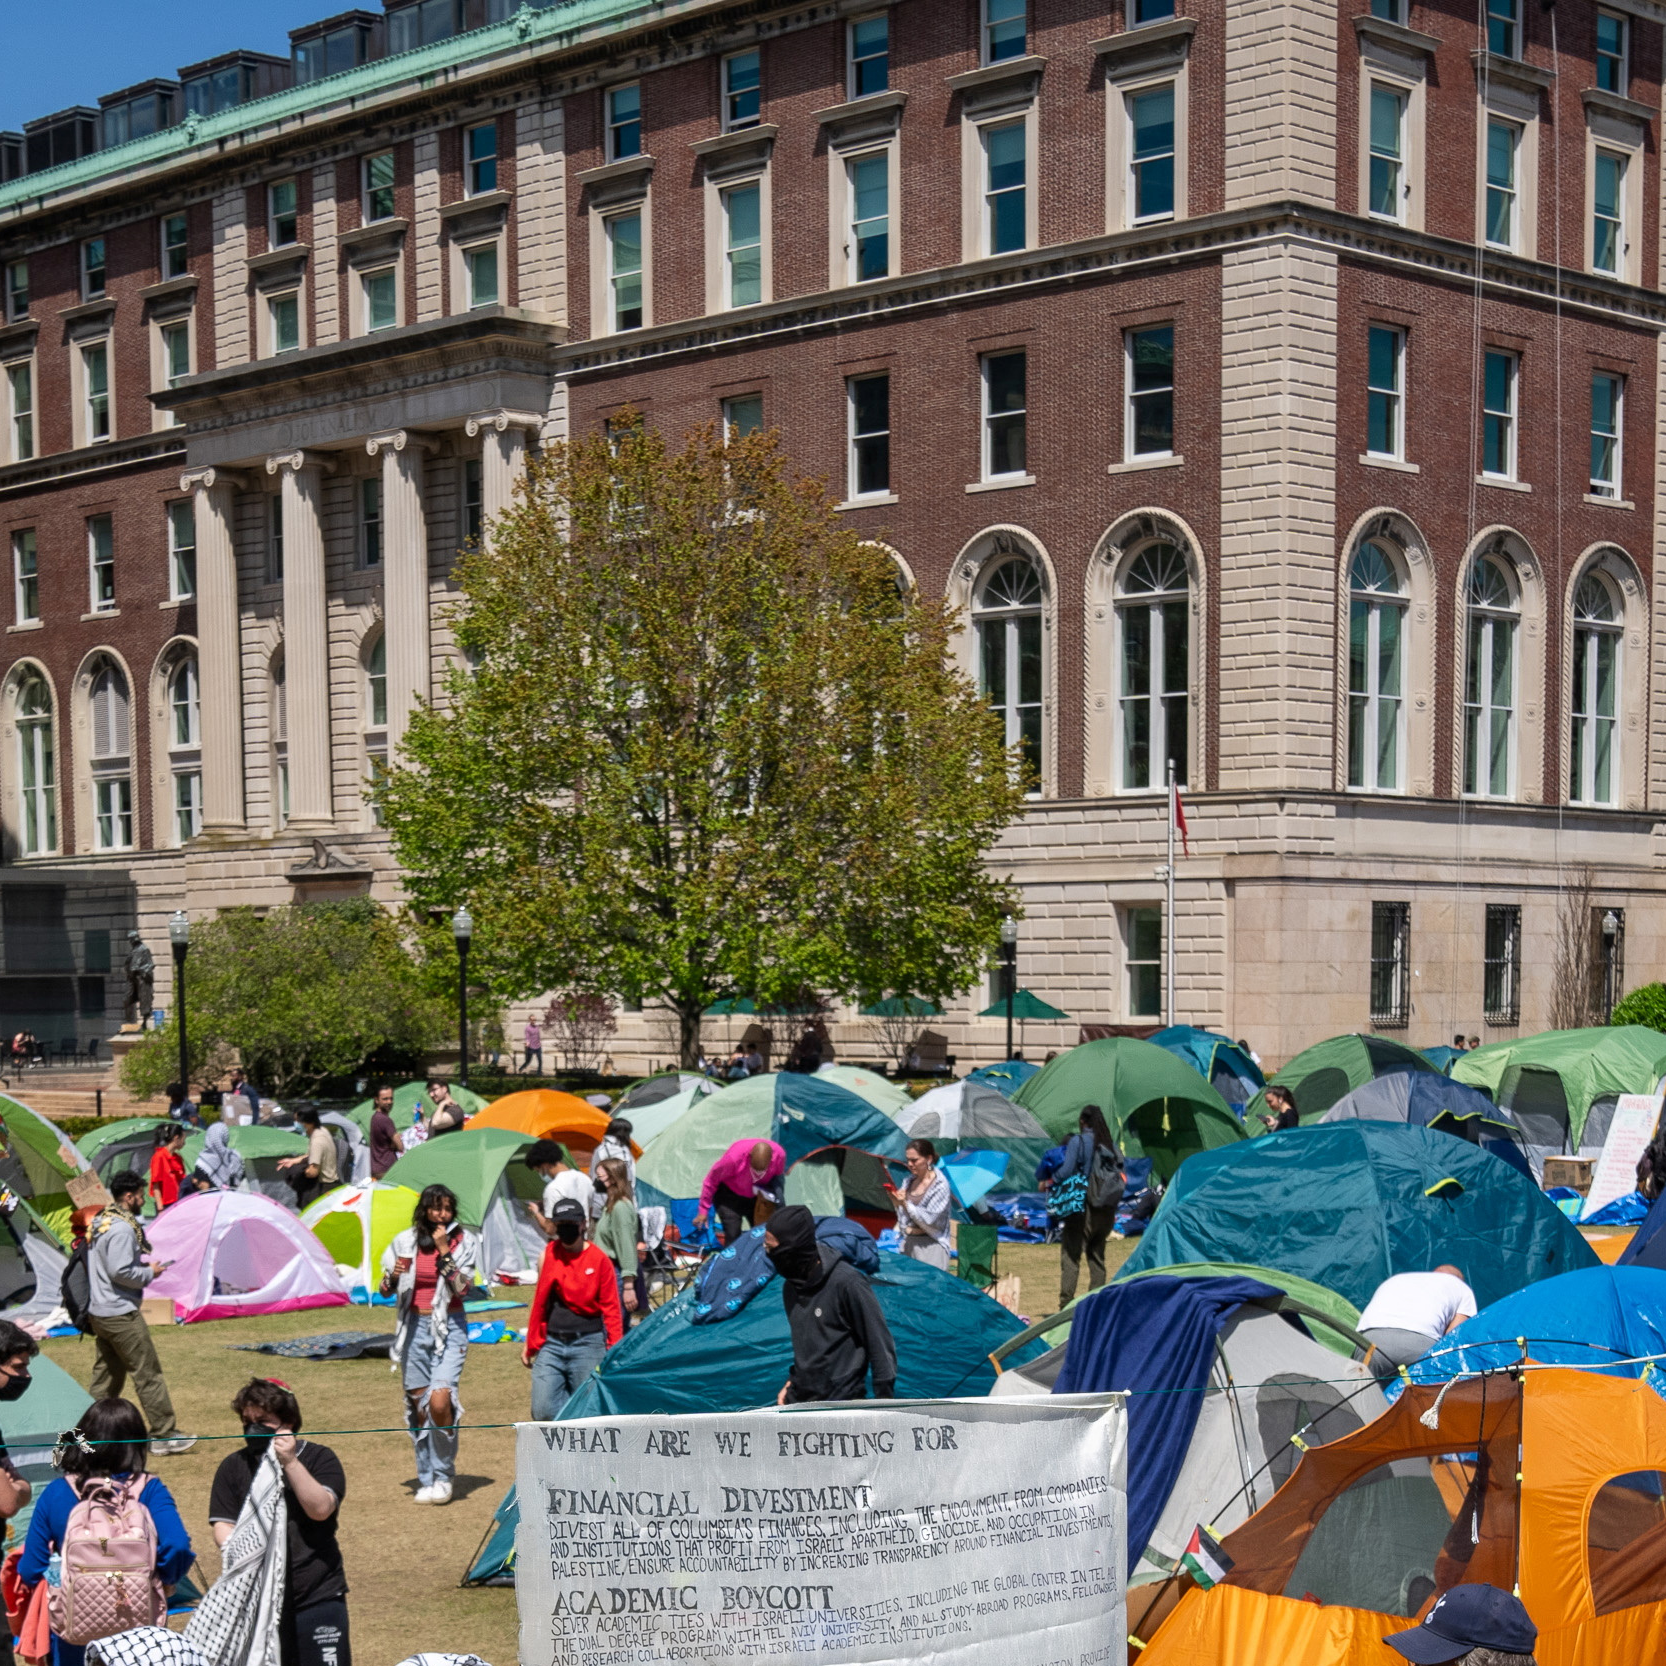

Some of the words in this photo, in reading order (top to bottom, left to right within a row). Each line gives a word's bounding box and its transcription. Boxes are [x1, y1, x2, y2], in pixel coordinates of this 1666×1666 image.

[540, 1425, 621, 1457] WHAT
[644, 1426, 692, 1458] ARE
[715, 1430, 752, 1459] WE
[777, 1430, 895, 1459] FIGHTING
[912, 1424, 958, 1452] FOR
[546, 1486, 700, 1517] FINANCIAL
[721, 1484, 874, 1511] DIVESTMENT
[549, 1520, 609, 1540] DIVEST
[611, 1520, 641, 1540] ALL
[646, 1520, 663, 1539] OF
[670, 1517, 754, 1539] COLUMBIA'S
[827, 1509, 909, 1536] INCLUDING
[916, 1504, 936, 1526] THE
[1014, 1484, 1044, 1510] FROM
[1046, 1474, 1109, 1504] COMPANIES
[553, 1588, 698, 1617] ACADEMIC
[721, 1583, 834, 1612] BOYCOTT
[637, 1643, 736, 1662] COLLABORATIONS
[736, 1641, 768, 1659] WITH
[769, 1637, 818, 1656] ISRAELI
[820, 1631, 877, 1652] ACADEMIC
[879, 1621, 971, 1643] INSTITUTIONS.
